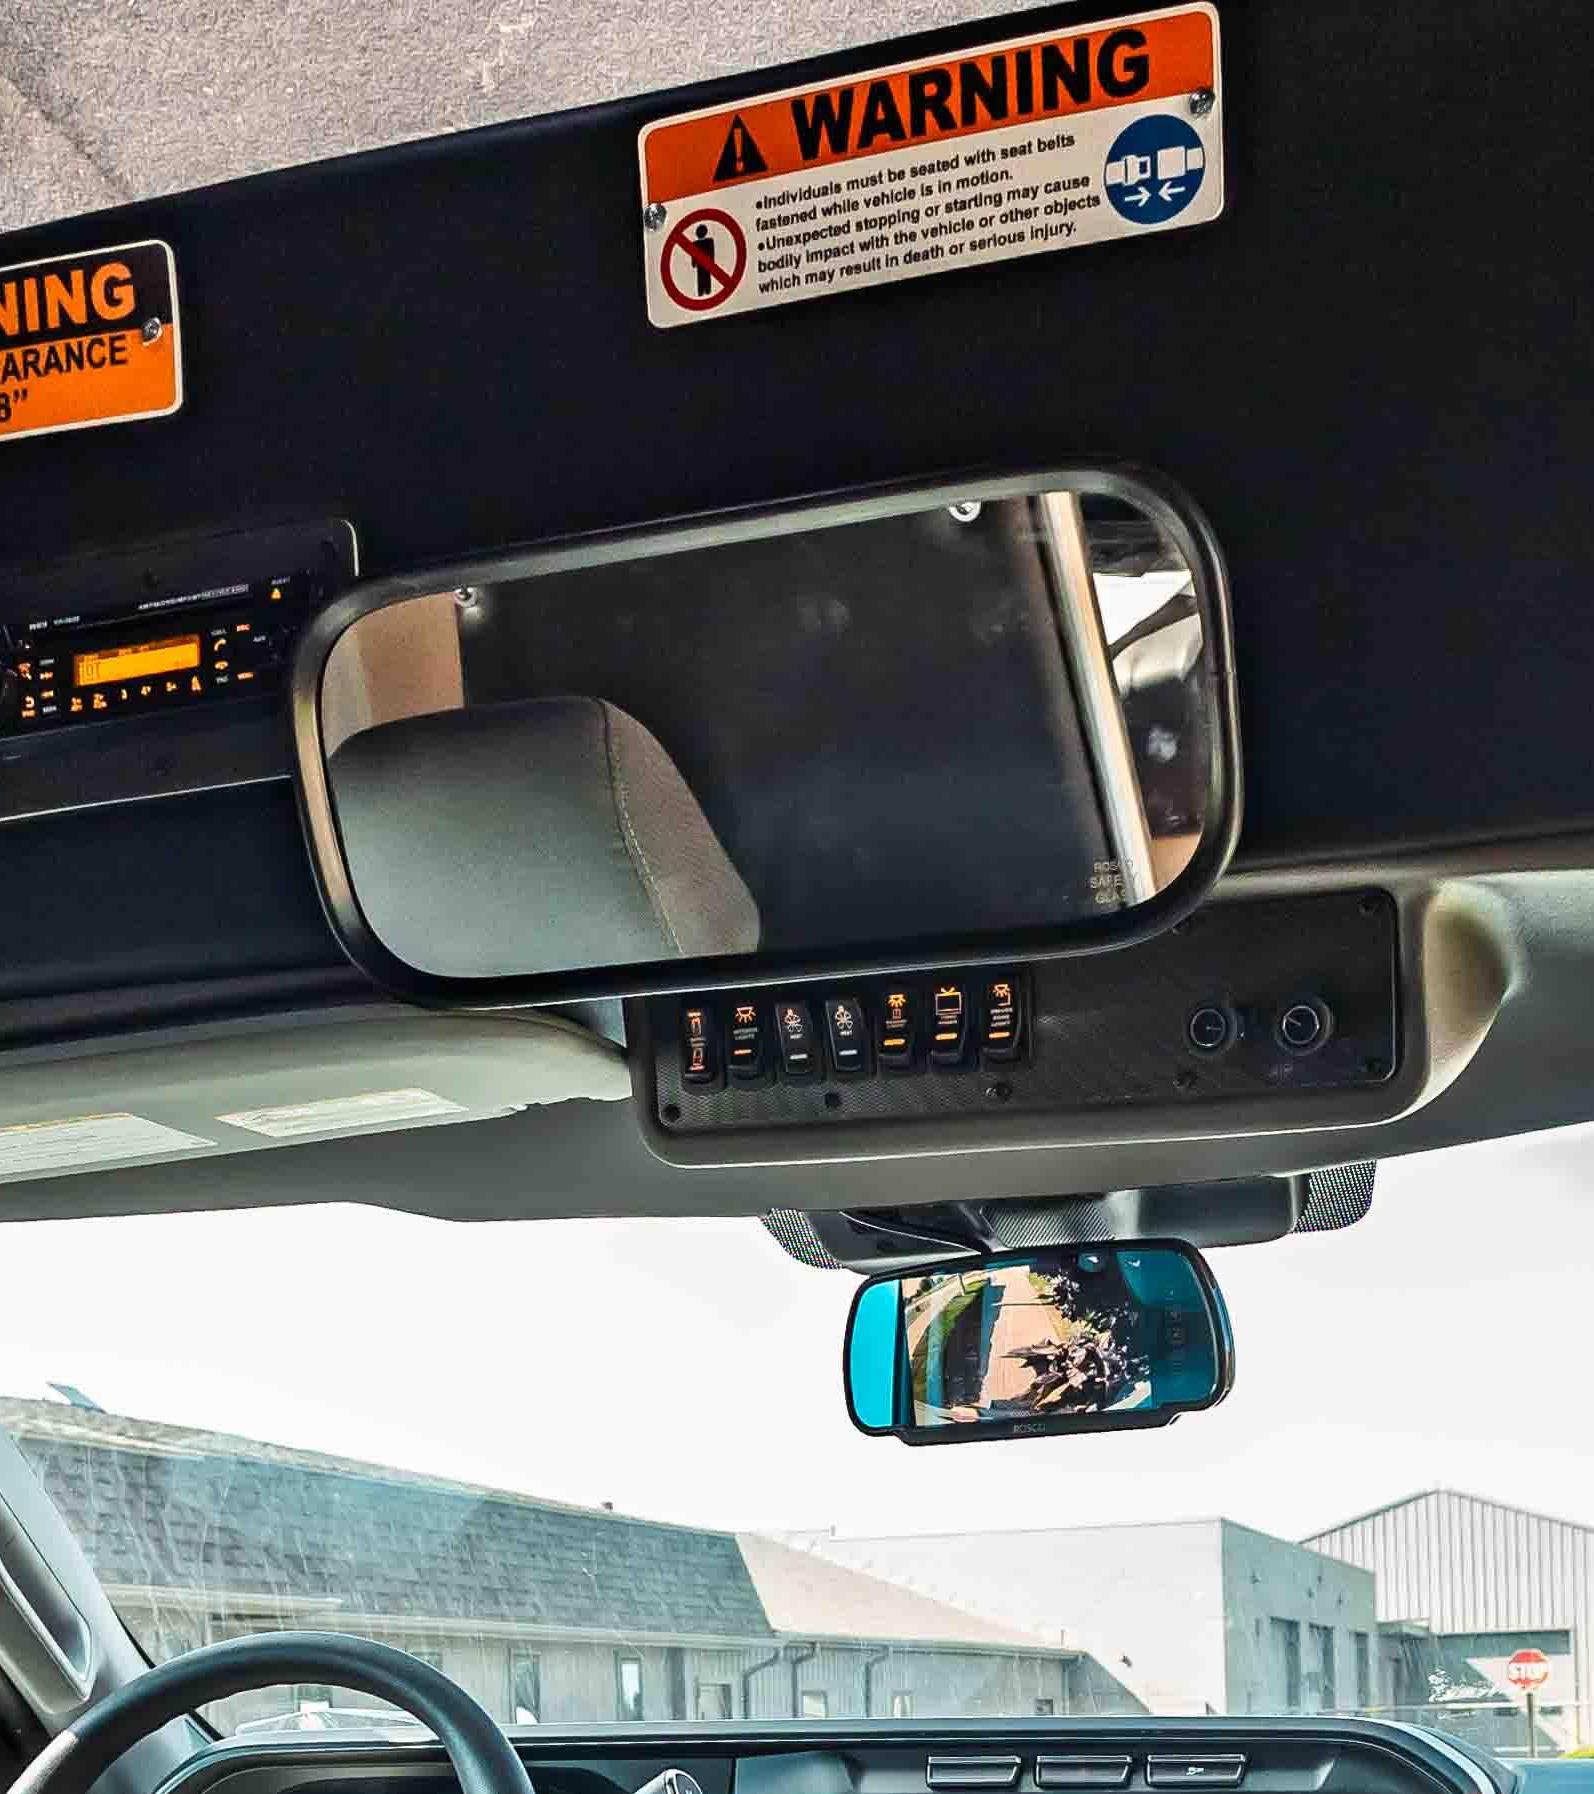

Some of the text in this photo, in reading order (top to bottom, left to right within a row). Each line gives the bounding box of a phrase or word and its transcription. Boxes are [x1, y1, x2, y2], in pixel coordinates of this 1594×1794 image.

[790, 29, 1150, 160] WARNING
[846, 172, 884, 191] must
[888, 163, 906, 183] be
[910, 154, 960, 178] seated
[964, 148, 996, 167] with
[1000, 141, 1033, 160] seat
[1037, 133, 1075, 153] belts
[755, 169, 1013, 232] fastened while vehicle is in motion.
[855, 209, 921, 233] stopping
[925, 203, 941, 217] or
[945, 191, 1003, 214] starting
[1007, 185, 1039, 206] may
[1044, 176, 1090, 195] cause
[758, 193, 1101, 273] bodily impact with the vehicle or other objects
[759, 220, 1077, 294] which may result in death or serious injury.
[1508, 1662, 1548, 1680] STOP
